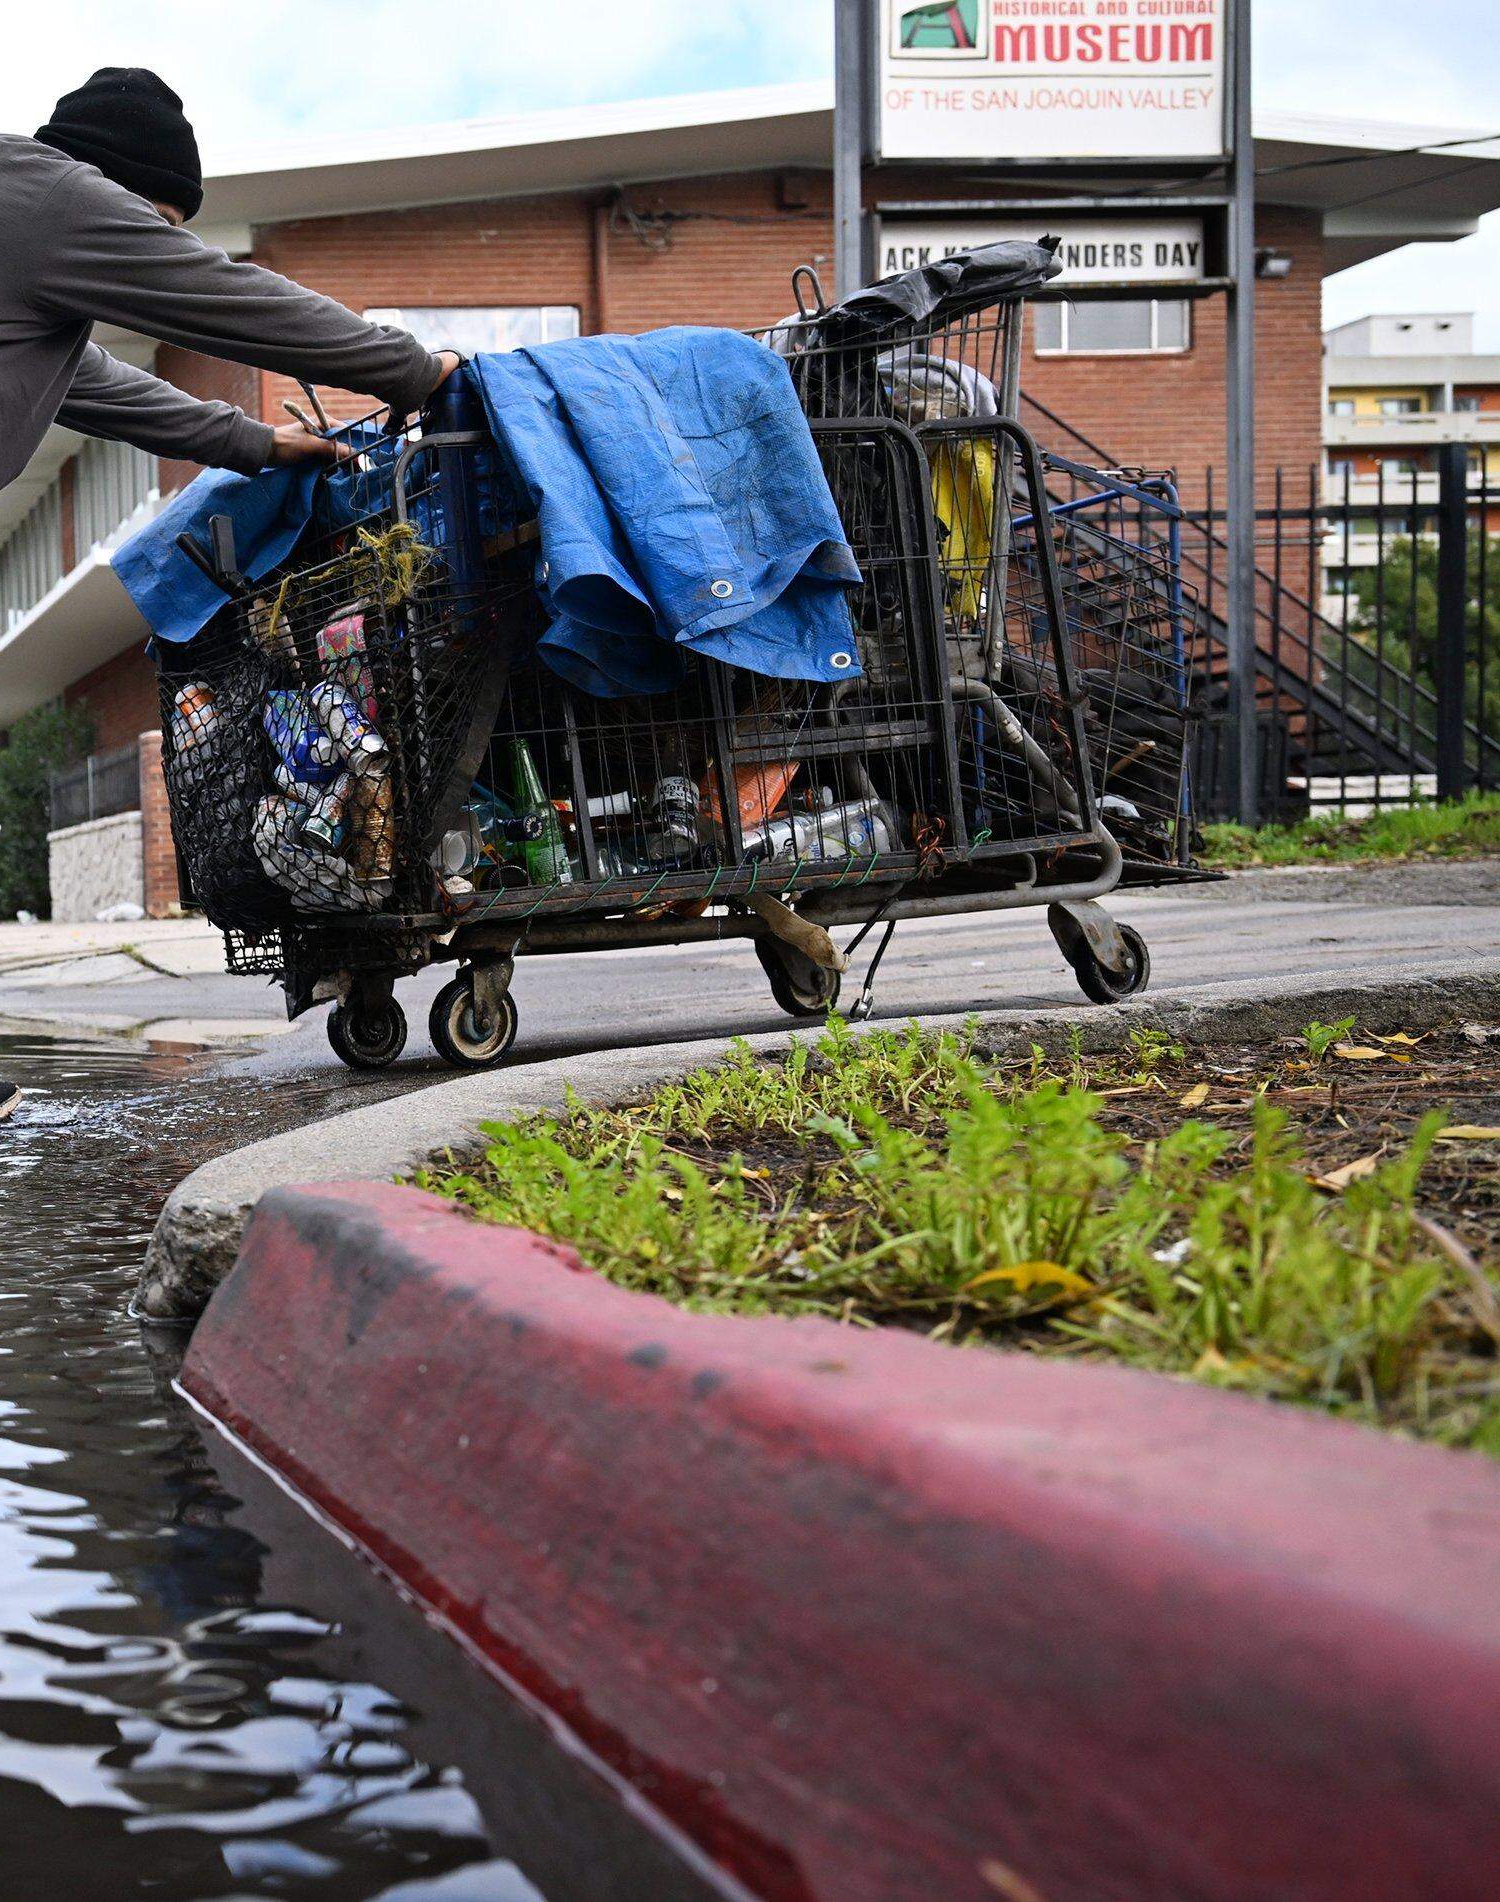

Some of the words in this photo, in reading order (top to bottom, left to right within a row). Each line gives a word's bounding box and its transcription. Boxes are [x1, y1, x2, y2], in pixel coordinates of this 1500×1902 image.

[994, 0, 1086, 16] HISTORICAL
[1096, 0, 1127, 15] AND
[1137, 0, 1215, 14] CULTURAL
[994, 23, 1213, 62] MUSEUM
[886, 89, 914, 110] OF
[921, 89, 964, 111] THE
[971, 89, 1018, 110] SAN
[1024, 88, 1122, 110] JOAQUIN
[1128, 88, 1214, 109] VALLEY
[886, 246, 931, 271] ACK
[1155, 242, 1199, 267] DAY
